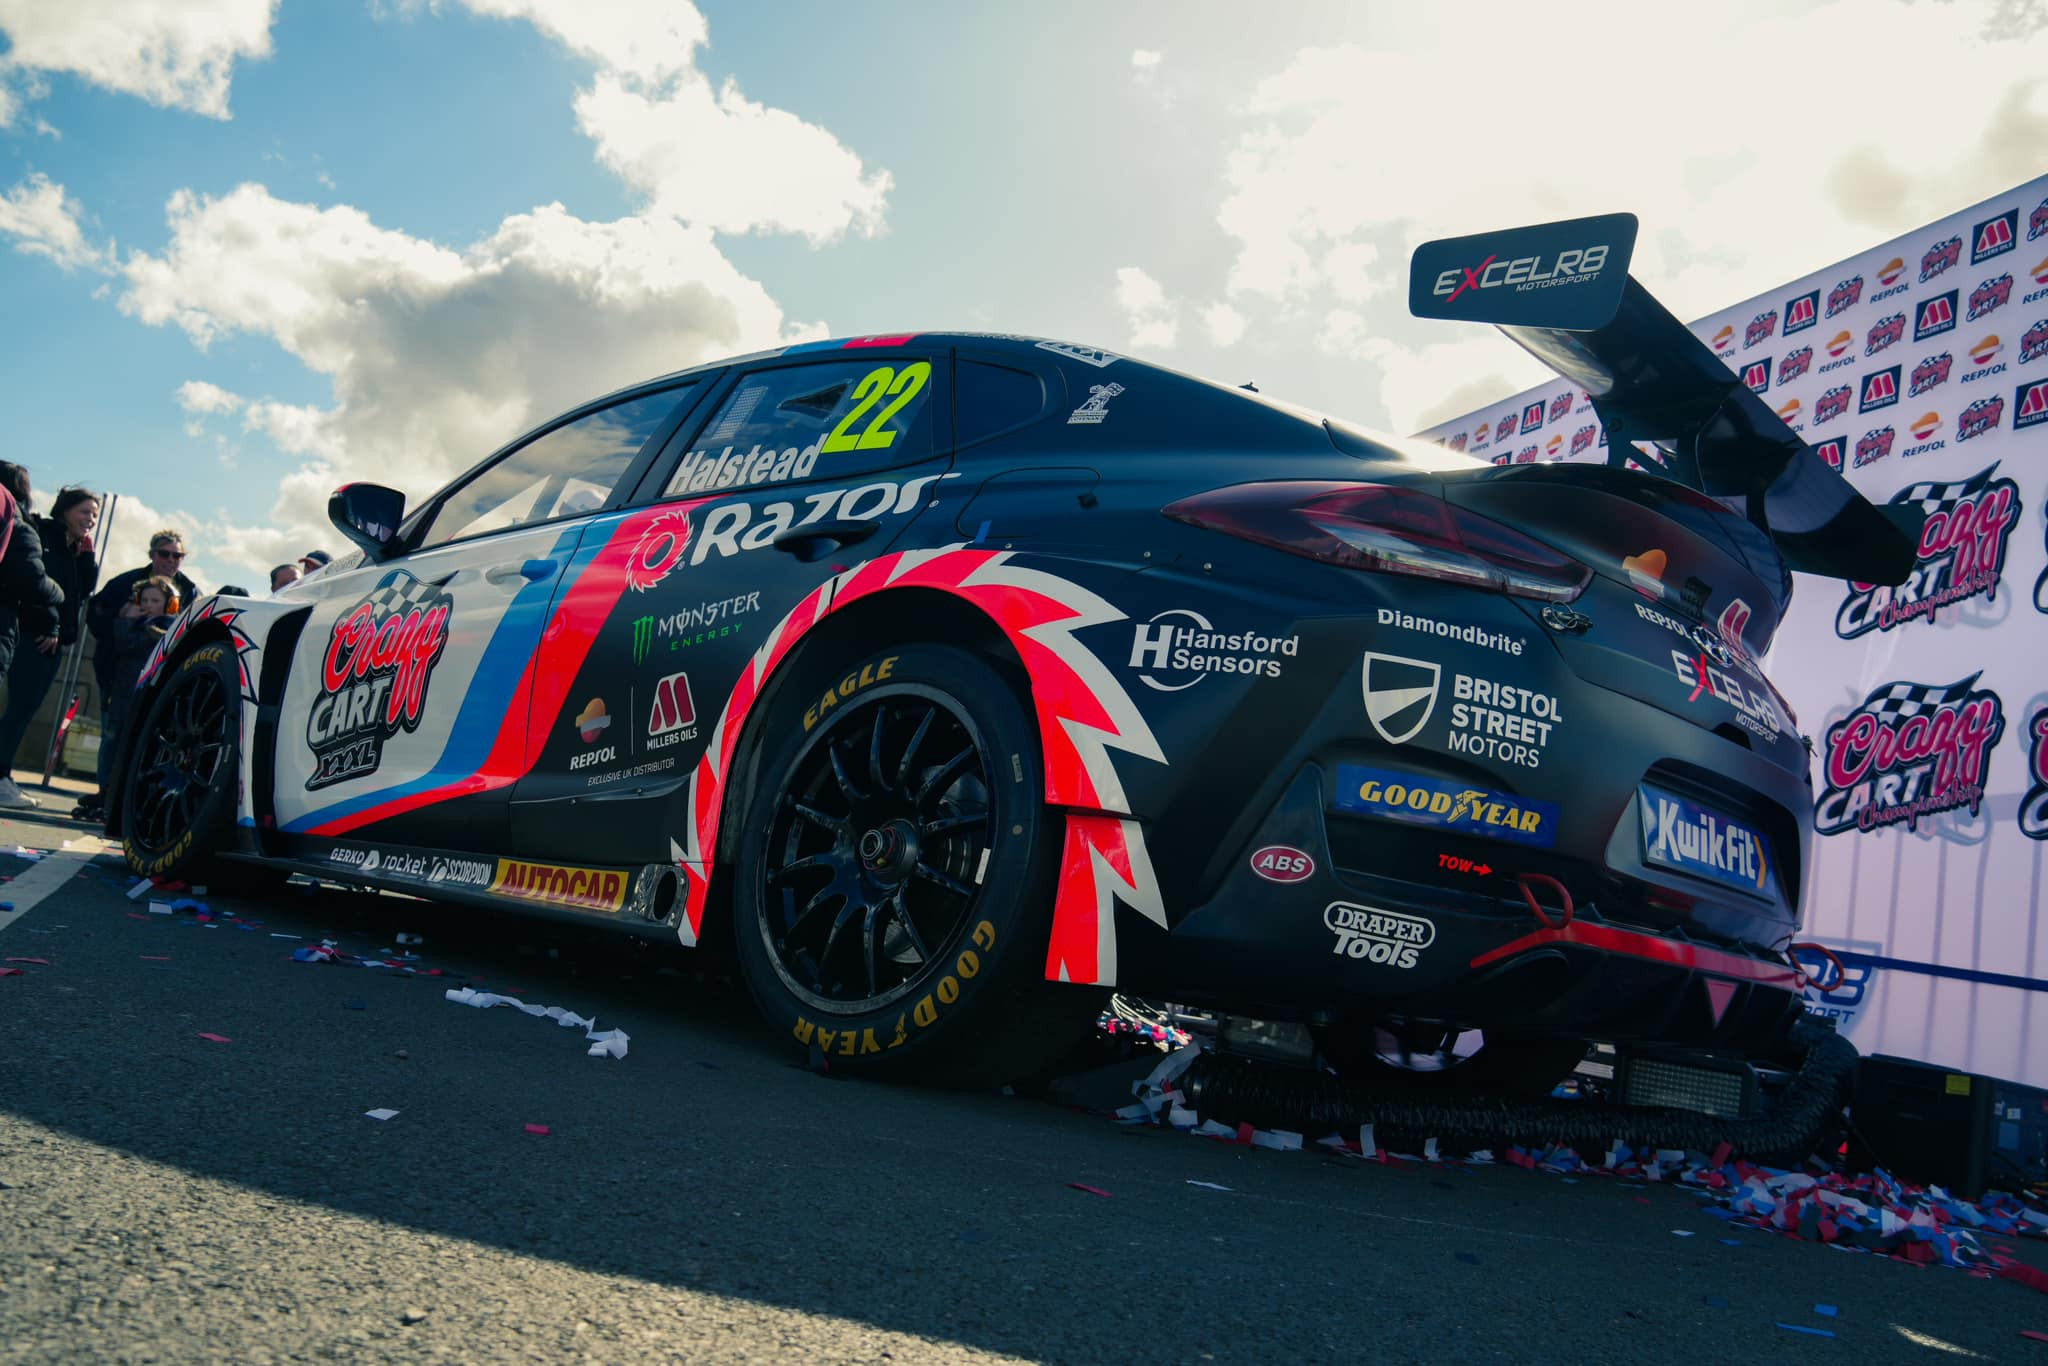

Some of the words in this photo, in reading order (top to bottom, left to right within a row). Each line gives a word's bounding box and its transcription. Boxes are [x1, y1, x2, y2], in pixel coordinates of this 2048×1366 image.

[1433, 245, 1609, 302] EXCELR8
[1515, 272, 1600, 293] MOTORSPORT
[1869, 283, 1910, 304] REPSOL
[1818, 354, 1857, 374] REPSOL
[1960, 362, 2008, 383] REPSOL
[820, 361, 932, 454] 22
[662, 433, 829, 496] Halstead
[1902, 440, 1945, 458] REPSOL
[690, 473, 961, 566] Razor
[671, 623, 742, 650] ENERGY
[1634, 603, 1692, 640] REPSOL
[1175, 627, 1299, 656] Hansford
[1172, 648, 1281, 677] Sensors
[802, 656, 900, 732] EAGLE
[1453, 673, 1563, 723] BRISTOL
[308, 677, 393, 745] CART
[1450, 703, 1552, 747] STREET
[646, 731, 686, 750] MILLERS
[681, 727, 698, 743] OILS
[1448, 730, 1540, 768] MOTORS
[570, 746, 616, 770] REPSOL
[587, 770, 621, 786] EXCLUSIVE
[622, 768, 633, 779] UK
[633, 757, 675, 775] DISTRIBUTOR
[1815, 763, 1936, 829] CART
[1858, 779, 1981, 829] Championship
[382, 854, 427, 875] rocket
[446, 860, 492, 885] SCORPION
[1259, 854, 1307, 873] ABS
[1438, 854, 1473, 873] TOW
[500, 862, 621, 909] AUTOCAR
[1334, 907, 1424, 943] DRAPER
[1333, 927, 1419, 968] Tools
